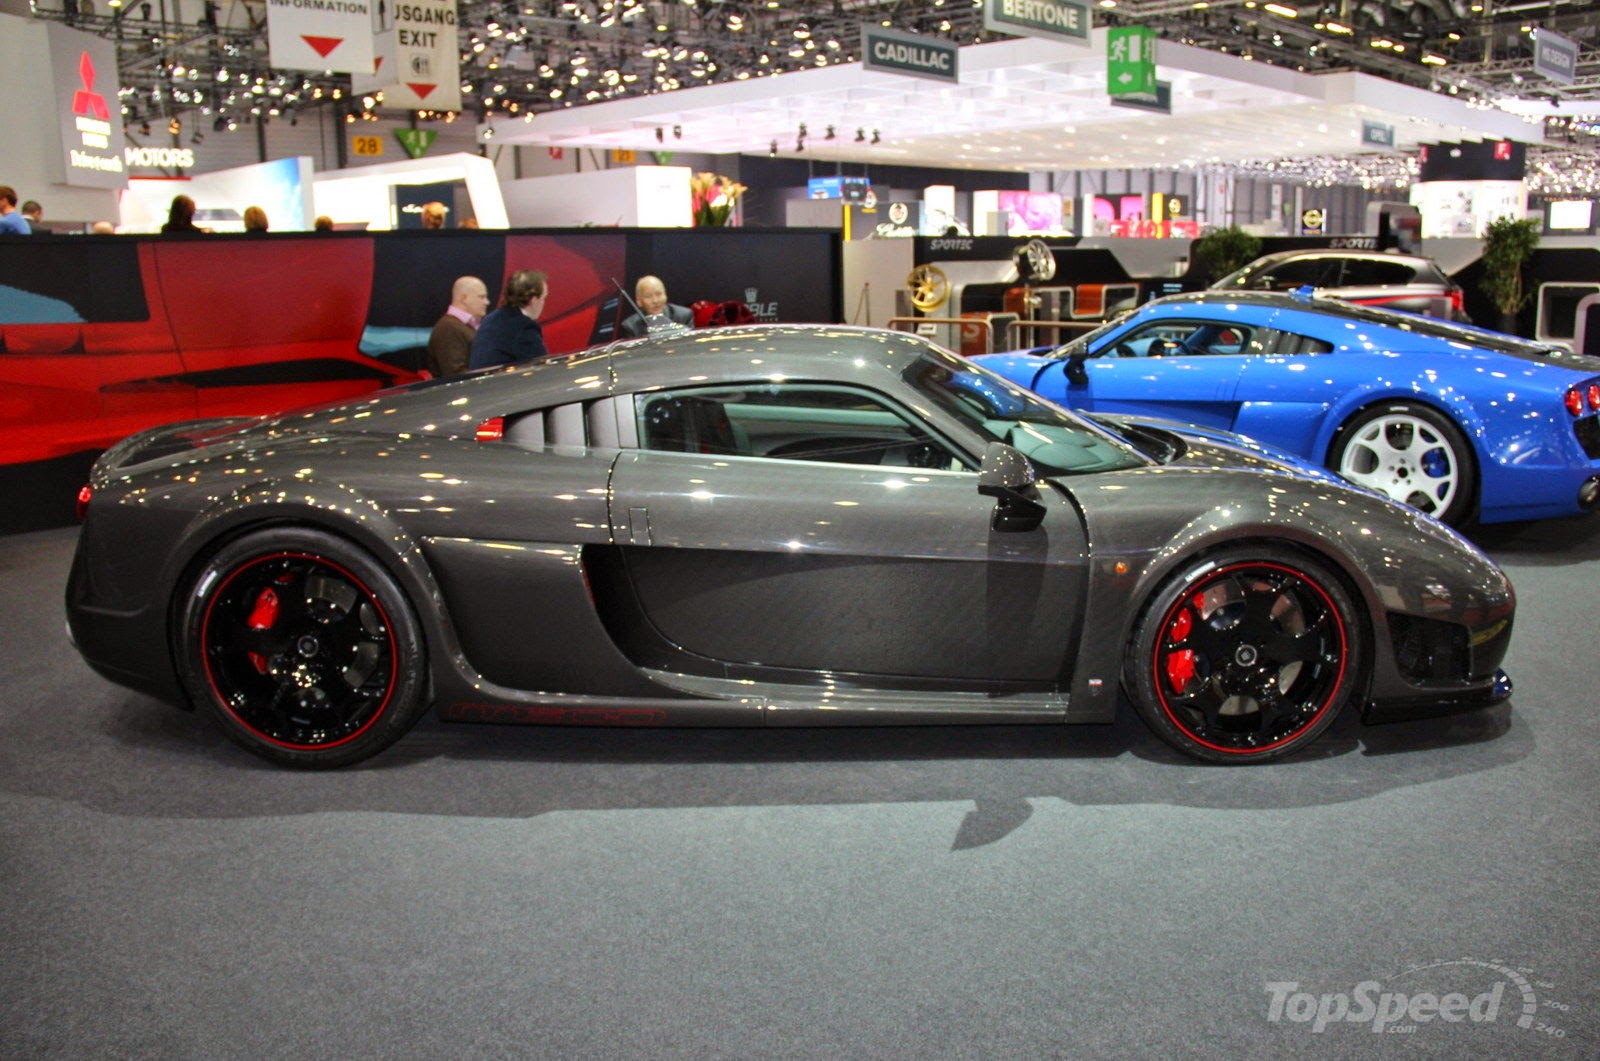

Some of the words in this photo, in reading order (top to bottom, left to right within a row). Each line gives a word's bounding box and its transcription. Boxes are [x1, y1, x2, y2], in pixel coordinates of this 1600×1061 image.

[270, 0, 368, 15] INFORMATION
[1003, 0, 1079, 30] BERTONE
[399, 29, 437, 48] EXIT
[874, 42, 950, 71] CADILLAC
[357, 136, 377, 154] 28
[124, 147, 195, 168] MOTORS
[930, 238, 974, 250] SPORTEC
